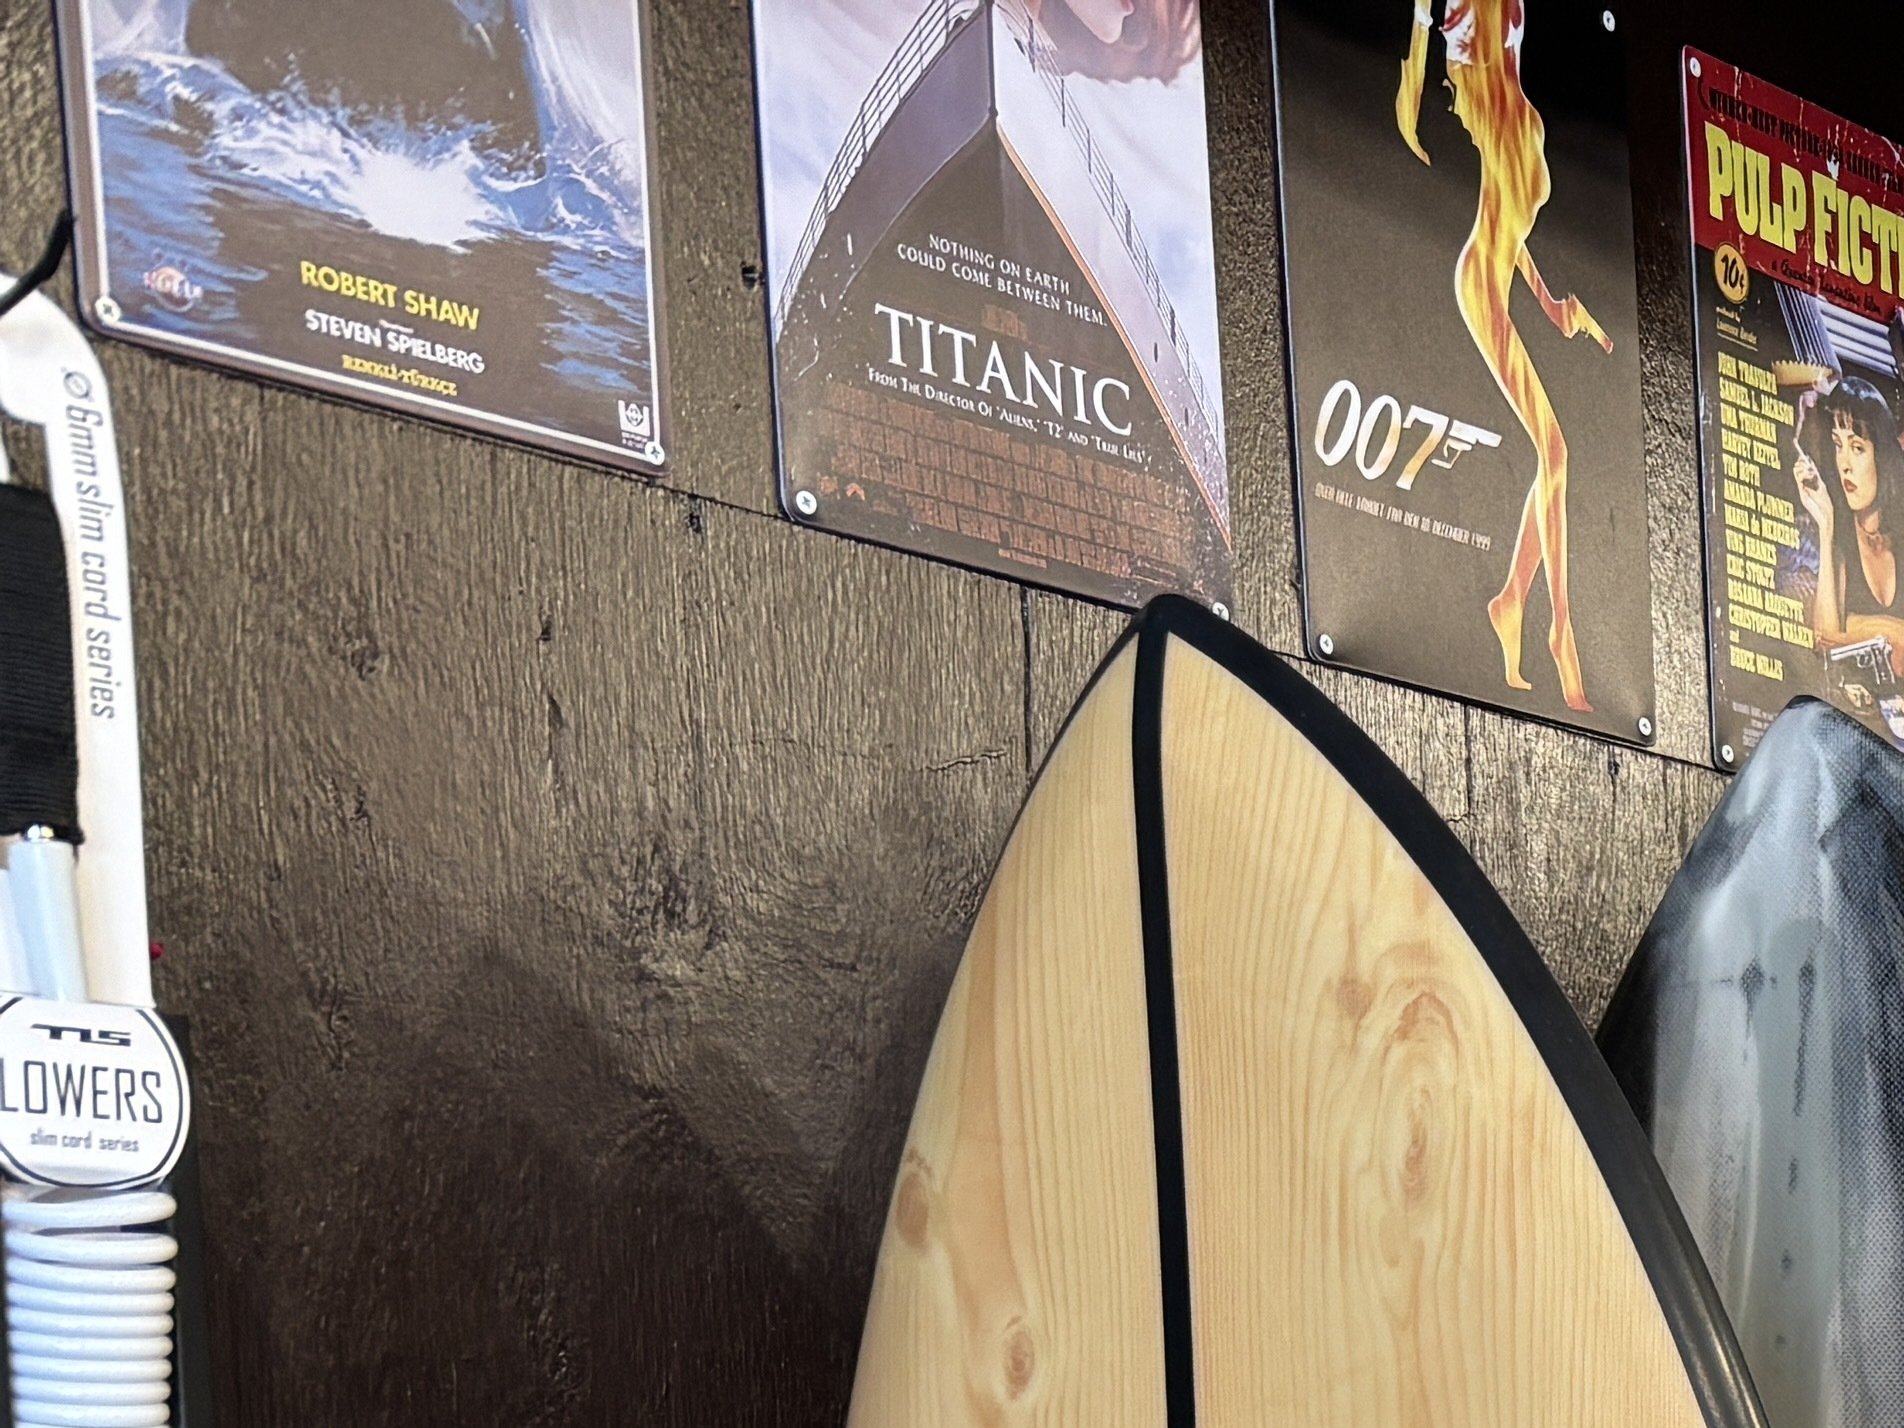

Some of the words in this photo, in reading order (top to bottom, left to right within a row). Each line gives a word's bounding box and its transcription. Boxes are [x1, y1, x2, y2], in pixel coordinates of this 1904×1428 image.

[1704, 120, 1807, 254] PULP
[300, 260, 397, 308] ROBERT
[403, 289, 480, 331] SHAW
[897, 243, 946, 272] COULD
[951, 262, 992, 289] COME
[997, 277, 1061, 311] BETWEEN
[1065, 300, 1108, 327] THEM.
[929, 233, 995, 270] NOTHING
[1000, 259, 1021, 279] ON
[1025, 267, 1070, 296] EARTH
[305, 309, 382, 348] STEVEN
[386, 331, 486, 374] SPIELBERG
[874, 302, 1132, 436] TITANIC
[64, 404, 104, 479] 6mm
[1314, 379, 1449, 491] 007
[78, 482, 115, 546] slim
[82, 551, 121, 619] cord
[88, 627, 115, 719] series
[0, 1058, 162, 1124] LOWERS
[30, 1127, 57, 1146] slim
[62, 1131, 92, 1149] cord
[99, 1136, 139, 1152] series
